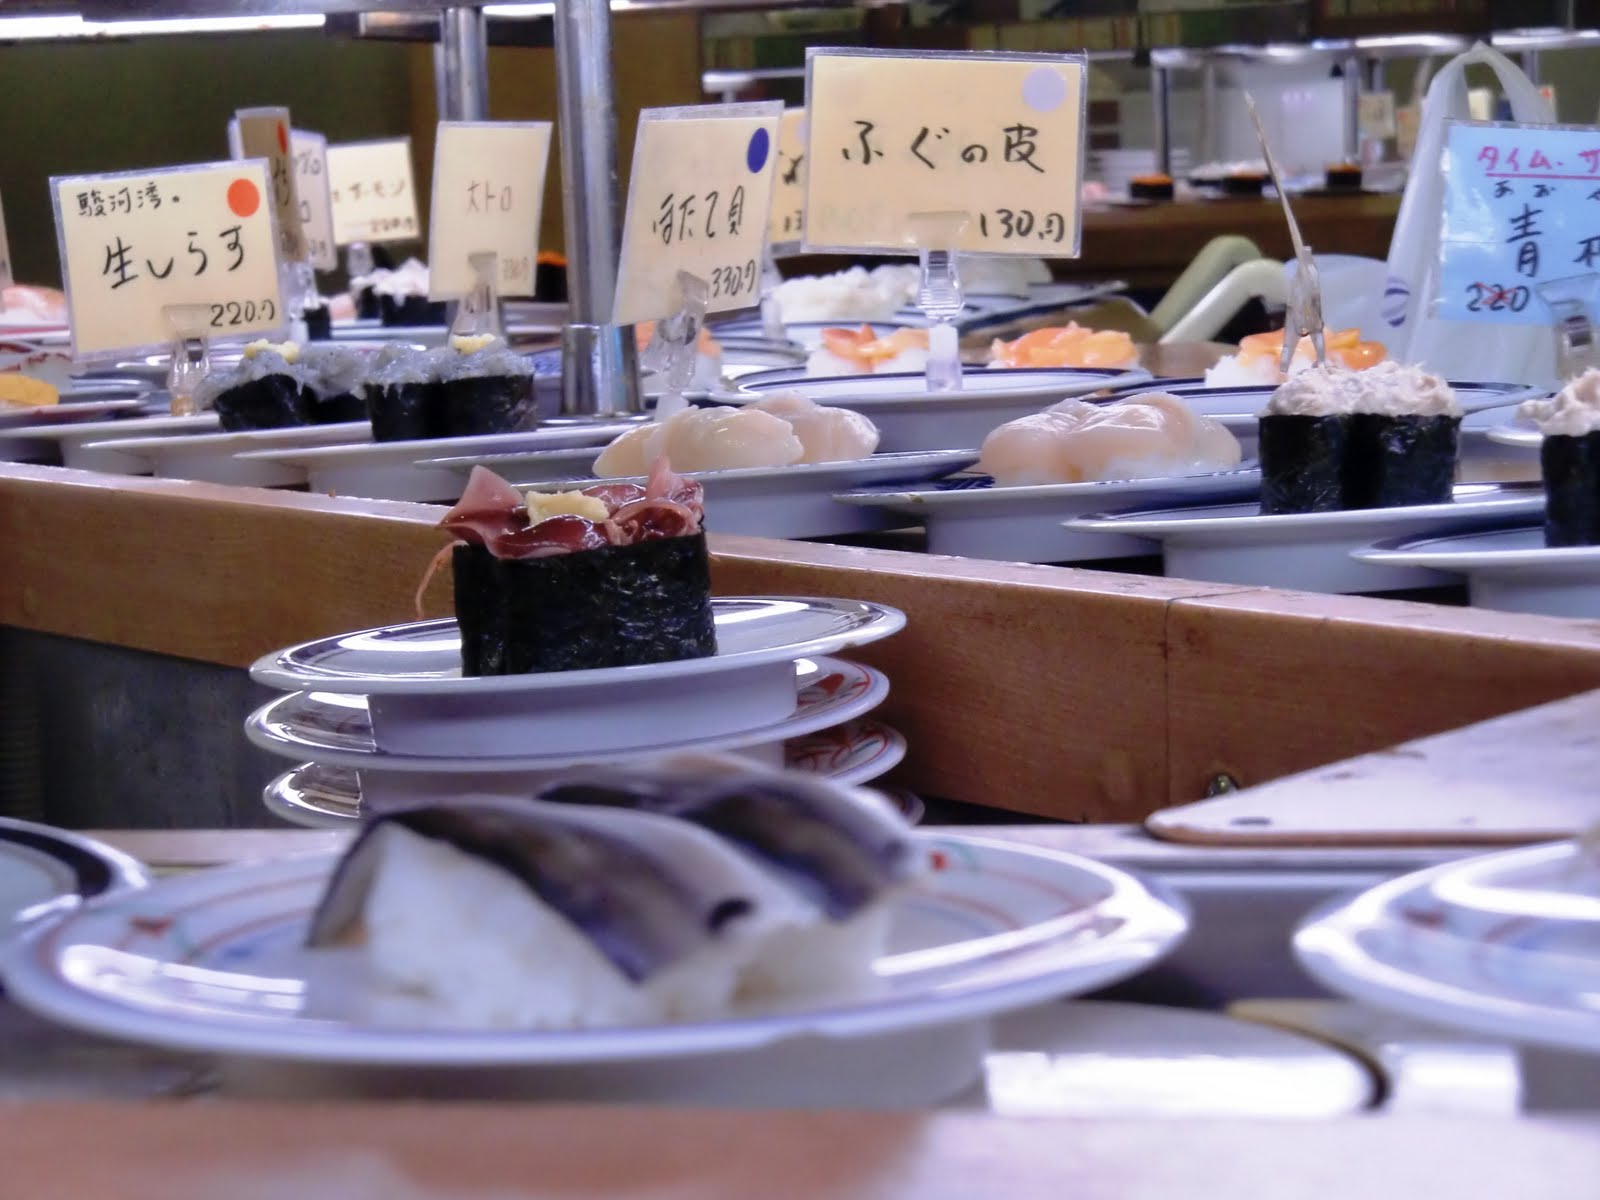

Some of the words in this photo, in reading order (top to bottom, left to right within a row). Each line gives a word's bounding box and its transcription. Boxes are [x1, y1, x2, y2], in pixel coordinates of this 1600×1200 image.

[841, 120, 1045, 173] ふぐの皮
[653, 185, 745, 245] ほたて貝
[102, 225, 244, 290] 生しらす
[1465, 282, 1531, 313] 220
